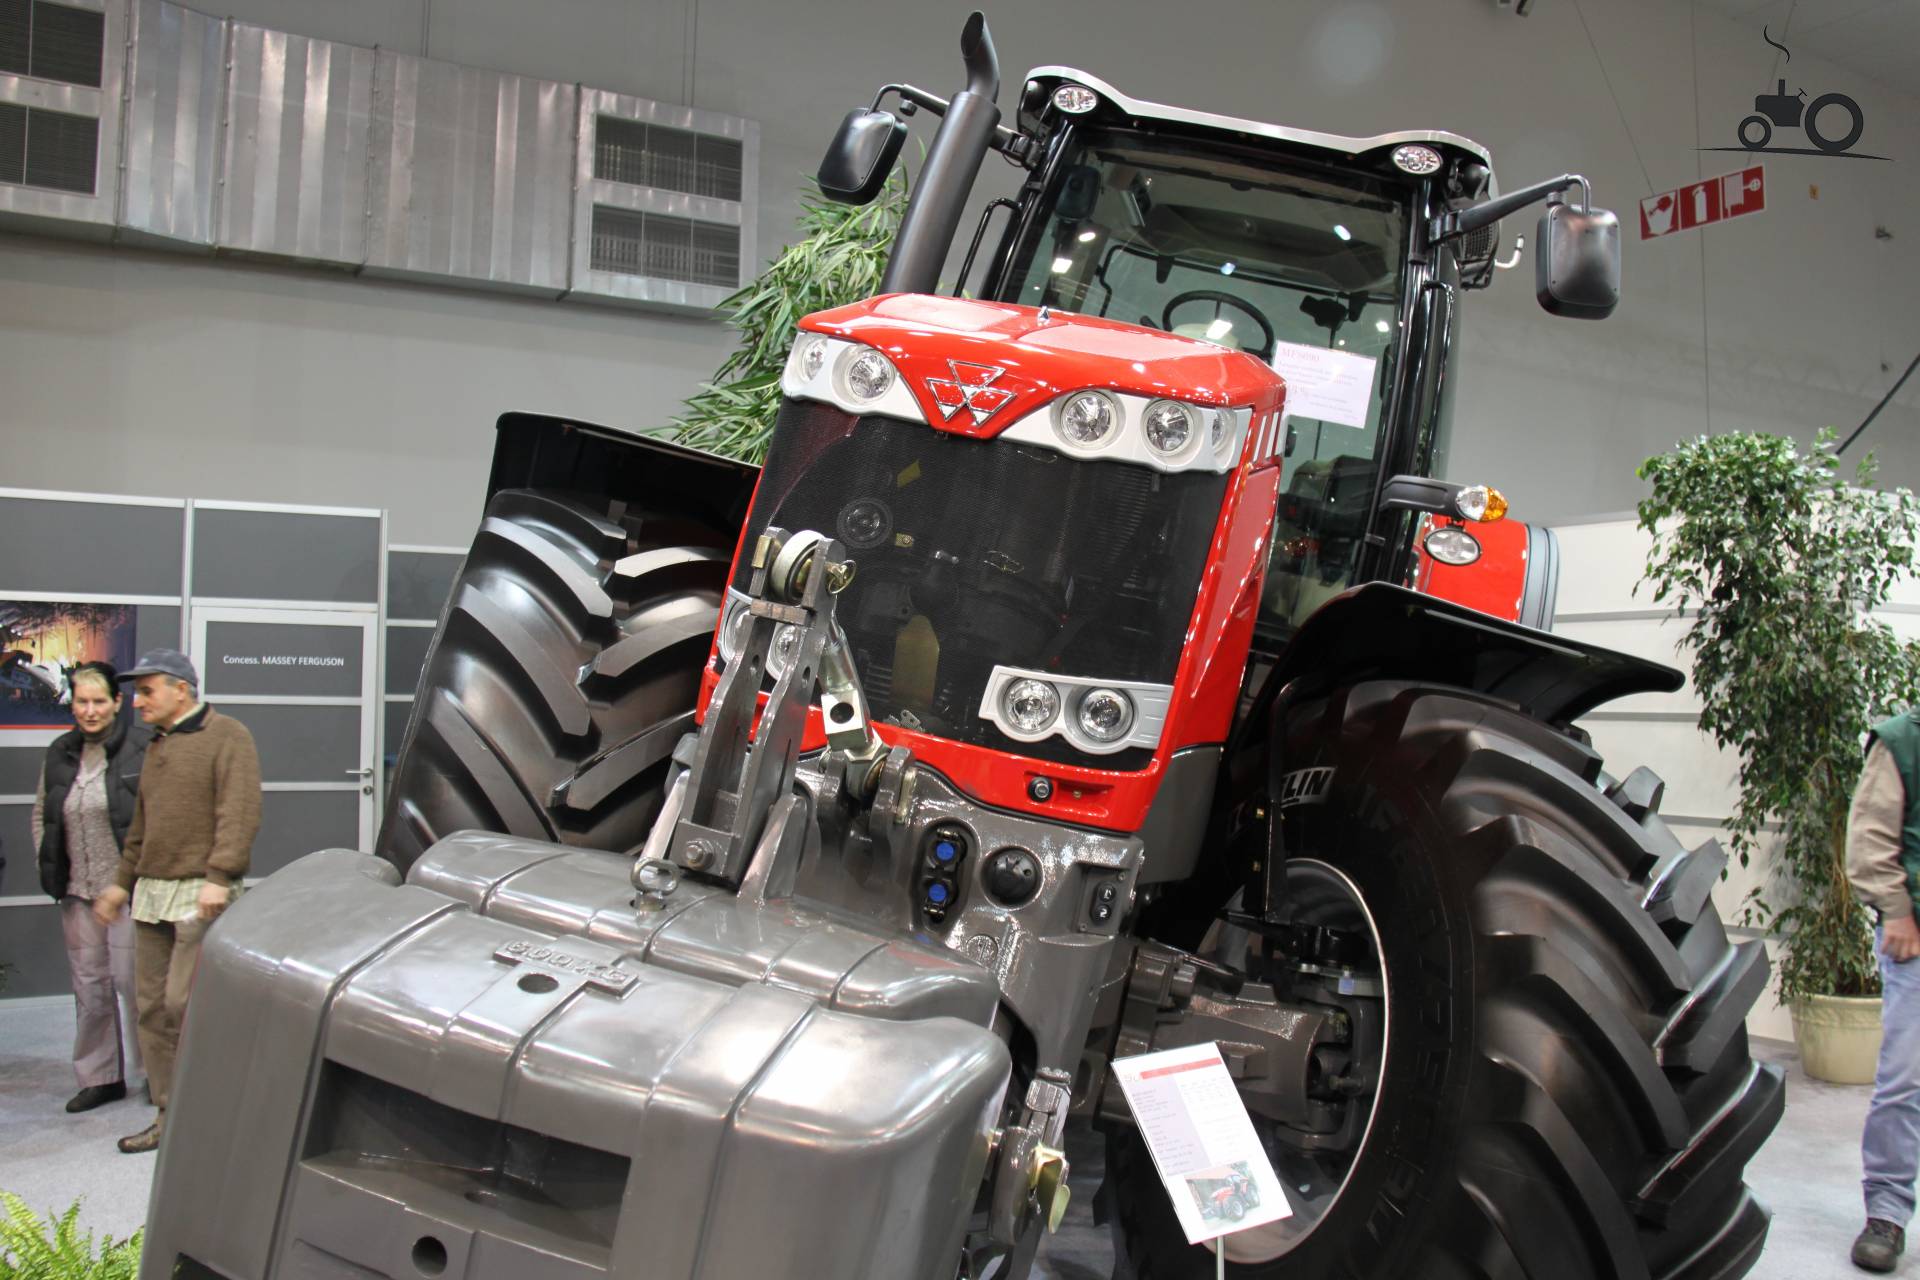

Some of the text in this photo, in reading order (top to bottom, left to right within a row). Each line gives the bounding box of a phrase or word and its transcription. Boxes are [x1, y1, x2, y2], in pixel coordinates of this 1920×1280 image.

[223, 655, 344, 666] Concess. MASSEY FERGUSON
[1281, 769, 1332, 799] LIN
